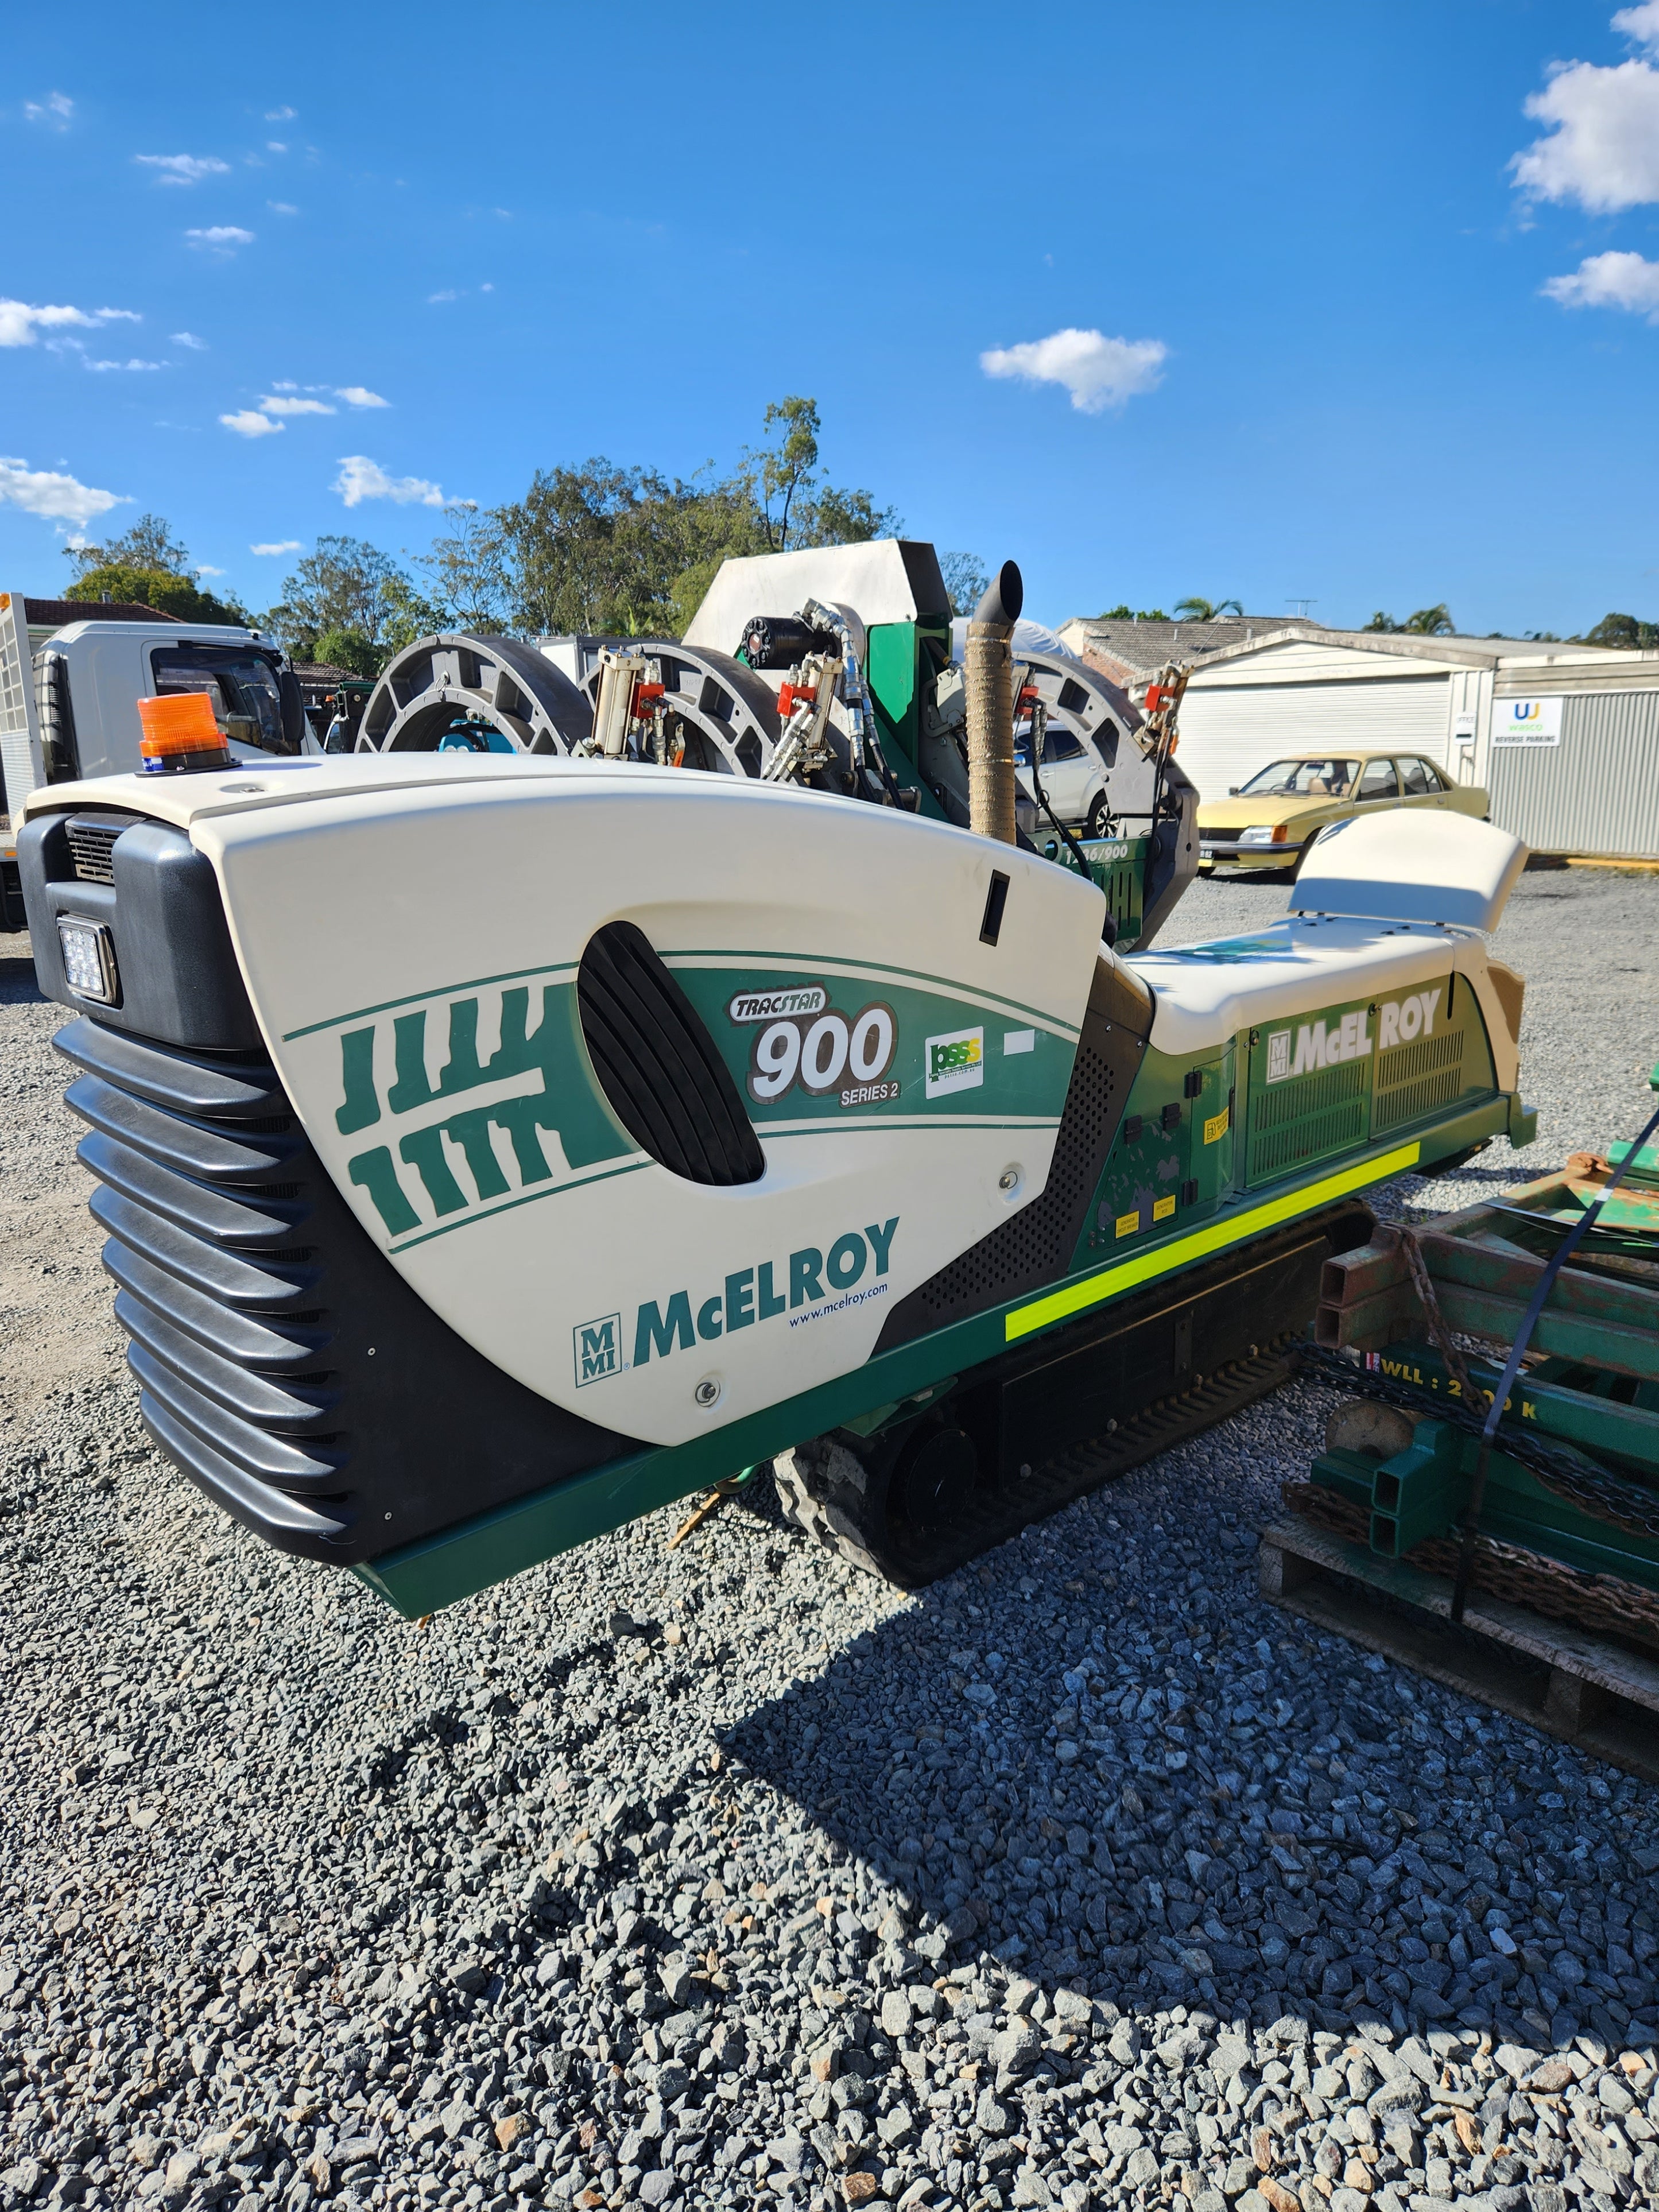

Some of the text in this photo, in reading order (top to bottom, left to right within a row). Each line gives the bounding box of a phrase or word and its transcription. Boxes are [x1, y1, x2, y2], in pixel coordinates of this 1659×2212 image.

[1066, 844, 1128, 865] 136/900
[735, 991, 821, 1017] TRACSTAR
[753, 1009, 893, 1098] 900
[840, 1082, 898, 1106] SERIES 2
[633, 1216, 900, 1368] McELROY
[789, 1283, 888, 1328] www.mcelroy.com
[1381, 1358, 1424, 1385] WLL
